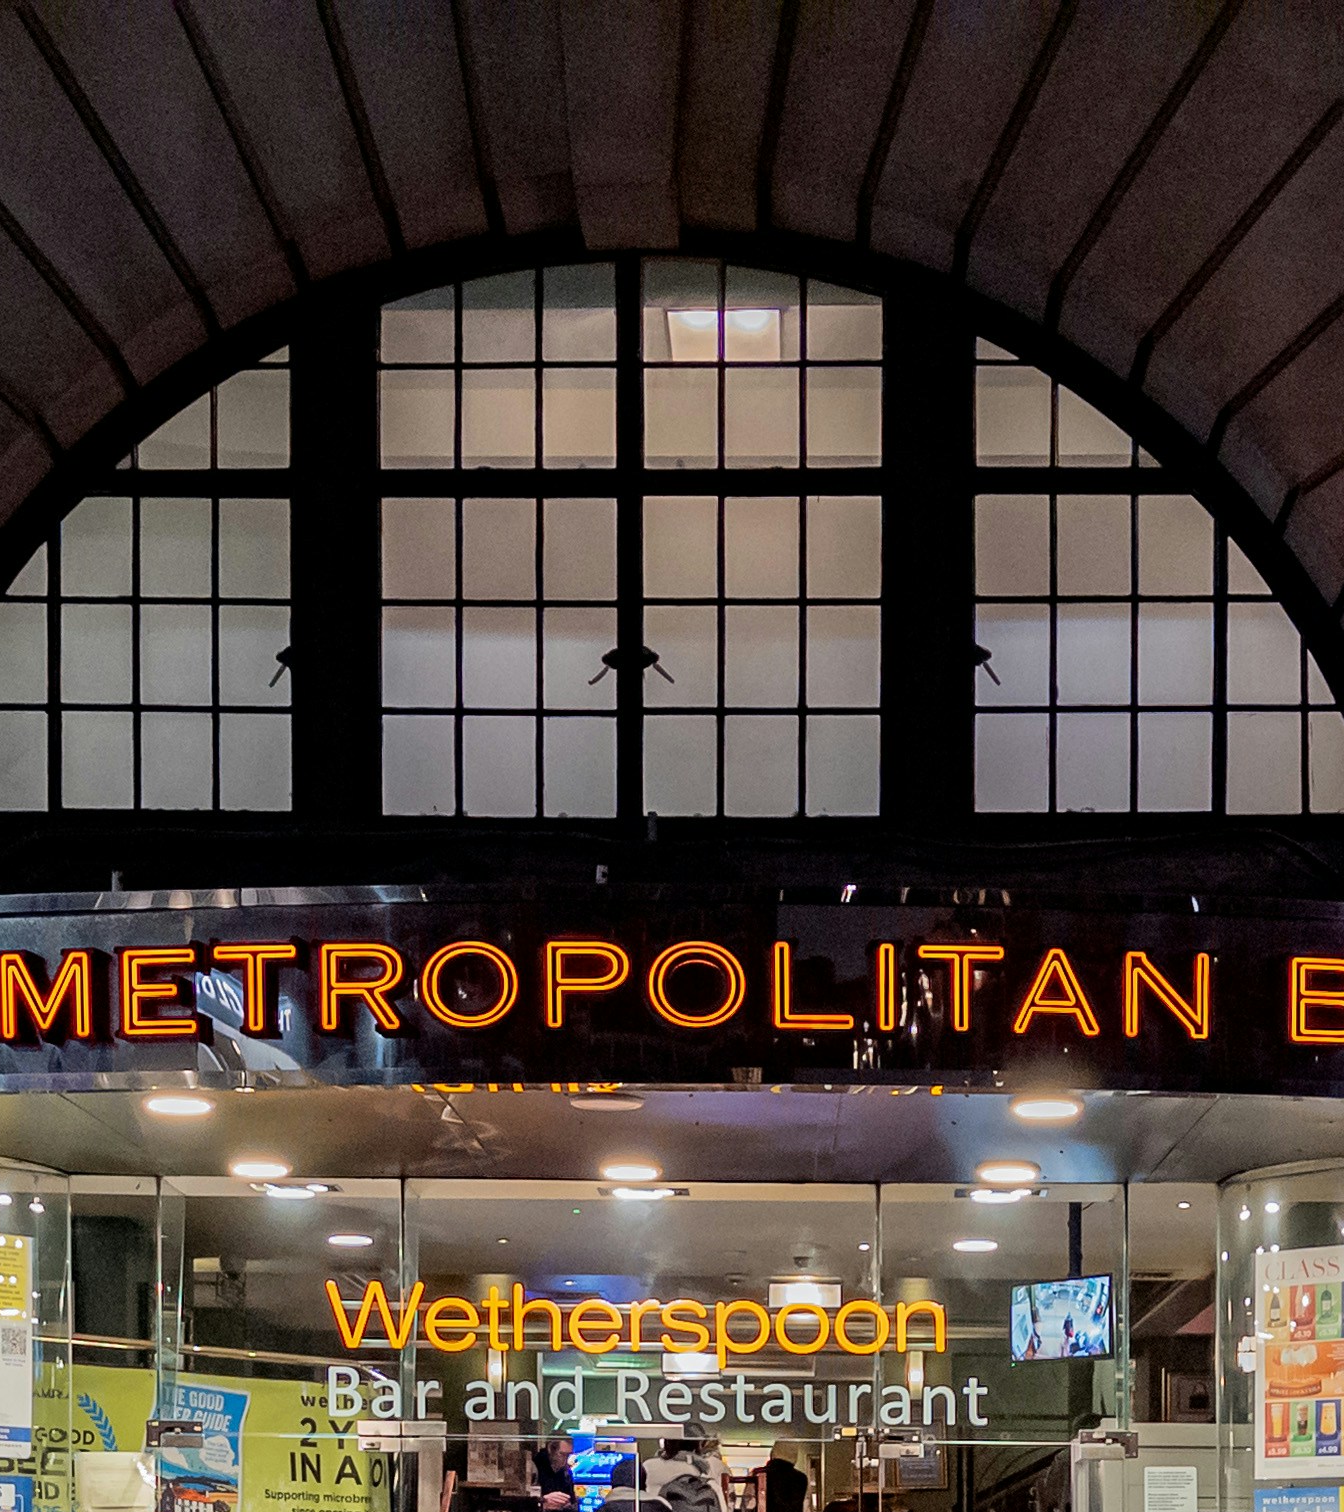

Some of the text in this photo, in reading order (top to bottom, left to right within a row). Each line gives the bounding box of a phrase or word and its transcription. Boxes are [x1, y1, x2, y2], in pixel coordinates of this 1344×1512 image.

[1265, 1256, 1341, 1281] CLASS
[324, 1279, 948, 1370] Wetherspoon
[189, 1391, 225, 1411] GOOD
[327, 1365, 990, 1428] Bar and Restaurant
[194, 1410, 232, 1432] GUIDE
[35, 1427, 95, 1445] GOOD
[300, 1418, 318, 1448] 2
[290, 1451, 321, 1483] IN
[335, 1455, 362, 1485] A
[264, 1489, 320, 1503] Supporting
[1262, 1495, 1336, 1505] wetherspoon
